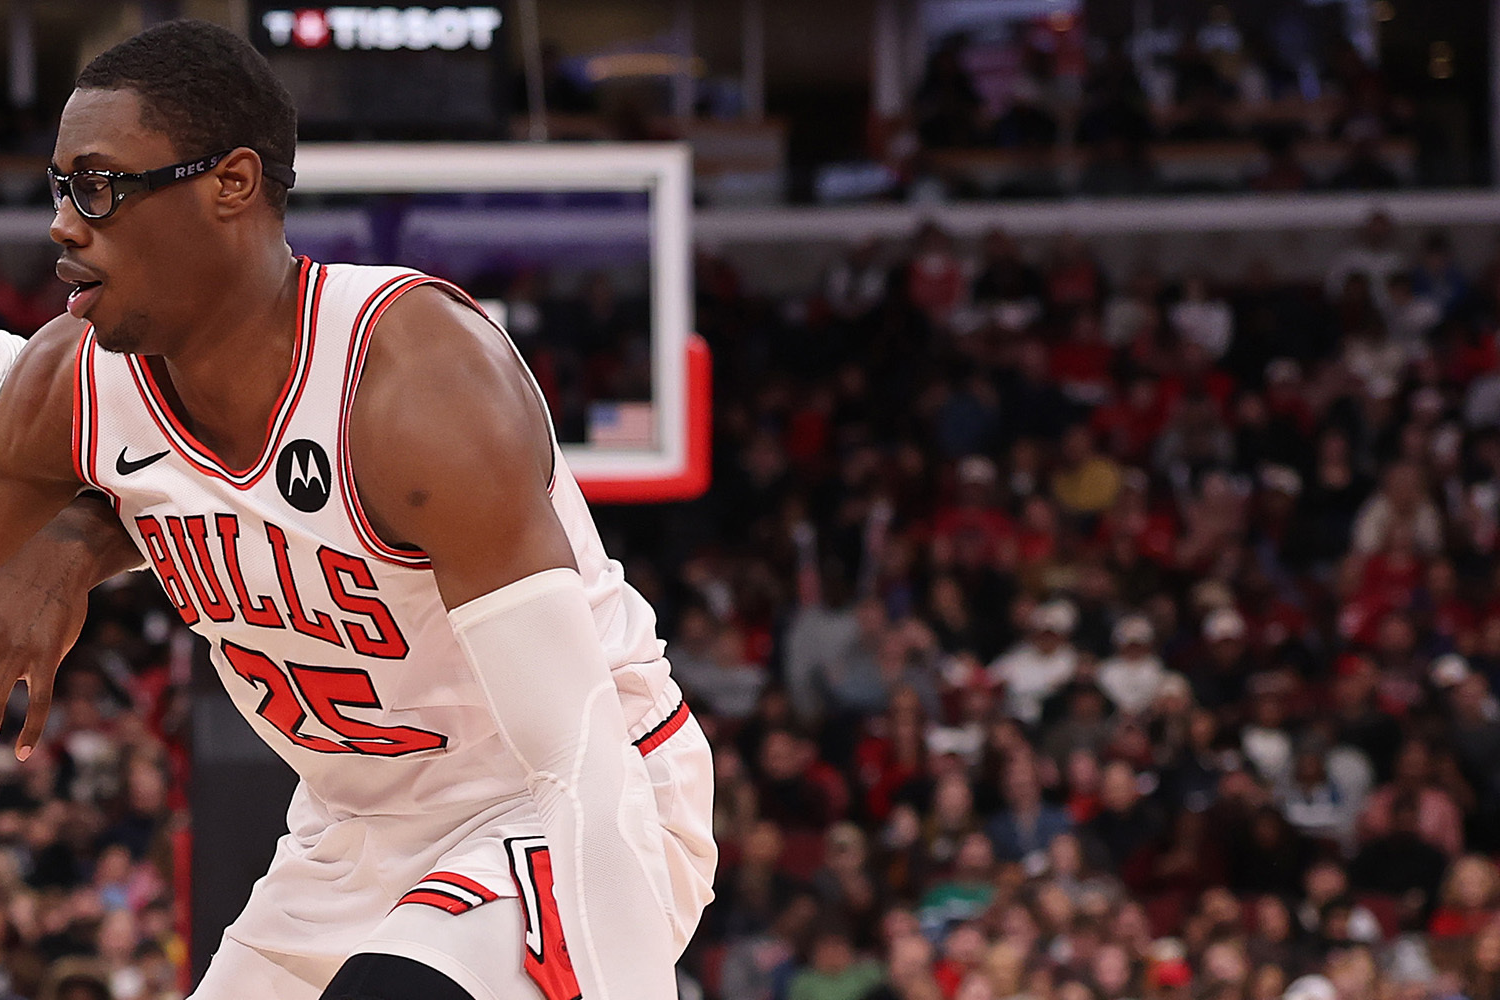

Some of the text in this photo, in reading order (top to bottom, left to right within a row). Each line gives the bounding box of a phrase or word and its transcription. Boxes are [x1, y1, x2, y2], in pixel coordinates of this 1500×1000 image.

[325, 6, 503, 51] TISSOT
[175, 161, 205, 179] REC
[135, 513, 410, 660] BULLS
[221, 638, 449, 757] 25
